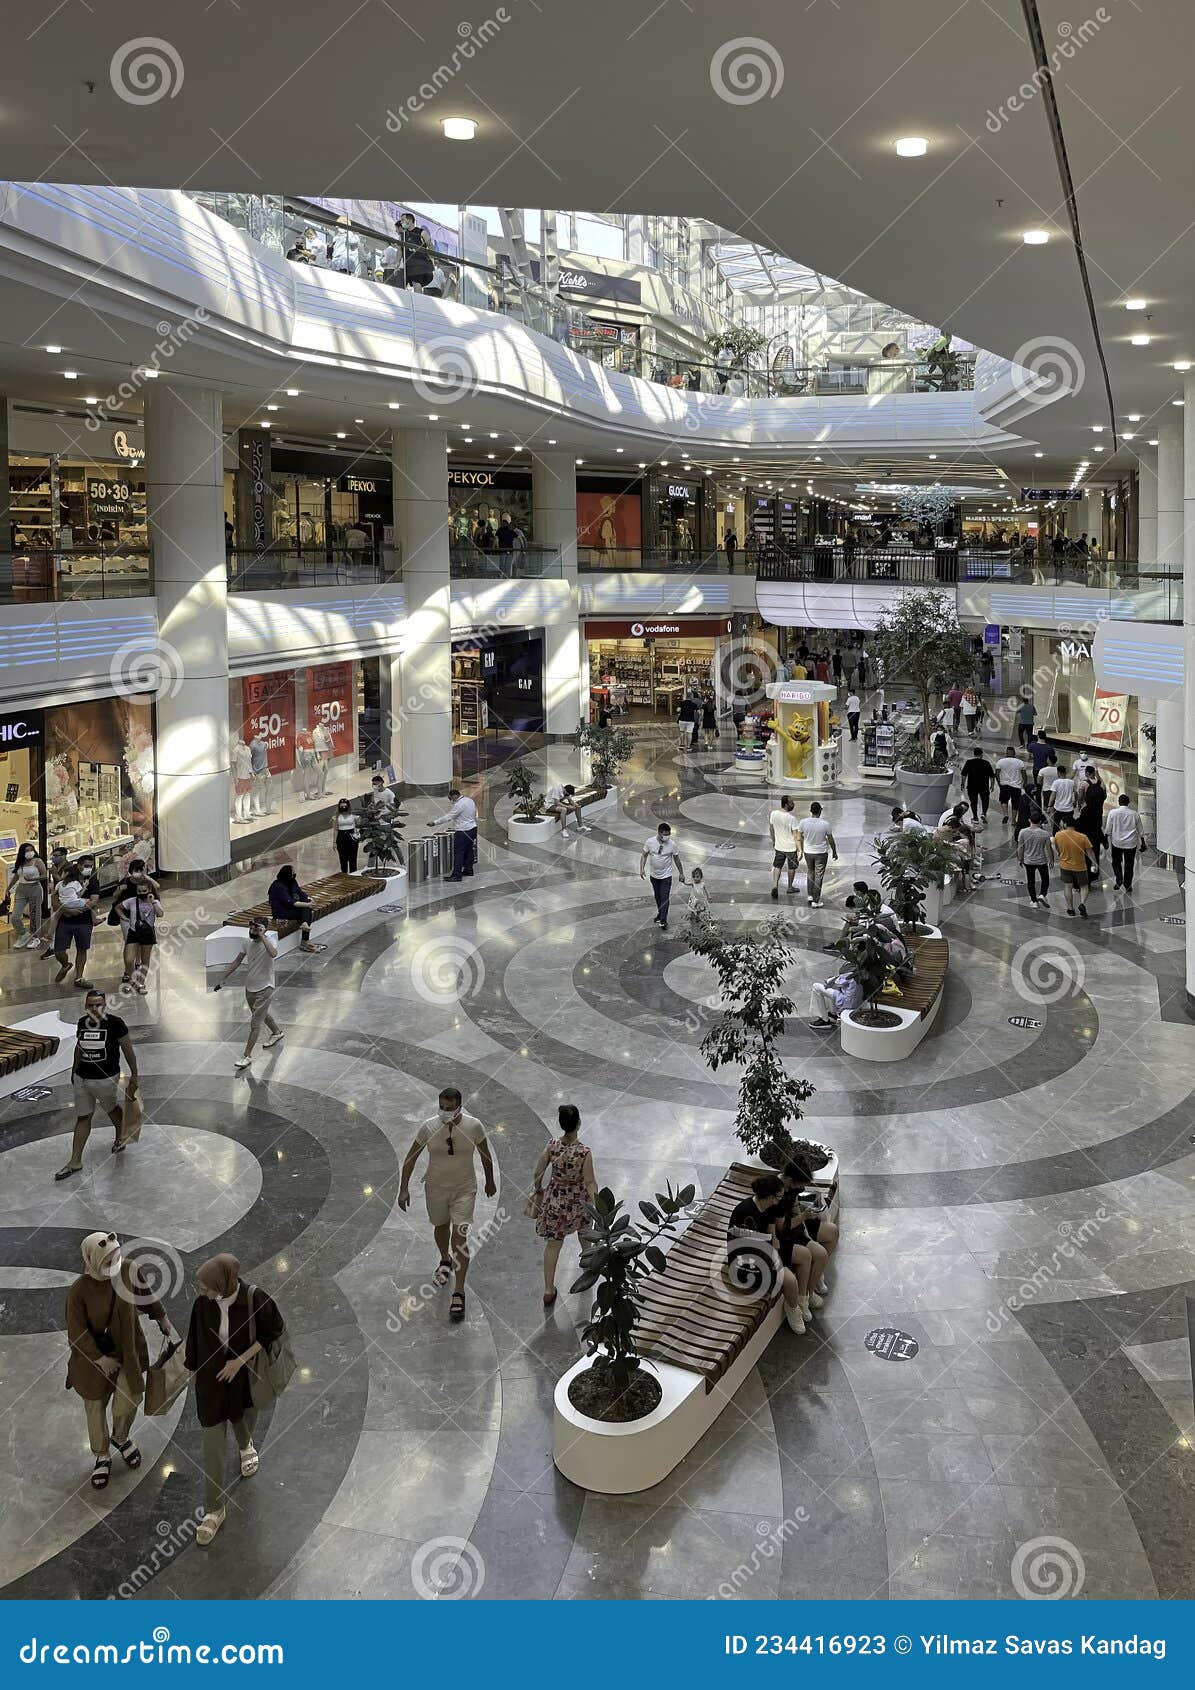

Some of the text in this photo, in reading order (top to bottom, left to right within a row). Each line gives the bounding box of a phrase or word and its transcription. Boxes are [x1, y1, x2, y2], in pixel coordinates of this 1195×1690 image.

[645, 625, 680, 633] vodafone
[1060, 641, 1093, 659] MA
[484, 652, 495, 668] GAP
[518, 678, 533, 690] GAP
[1100, 707, 1120, 724] 70
